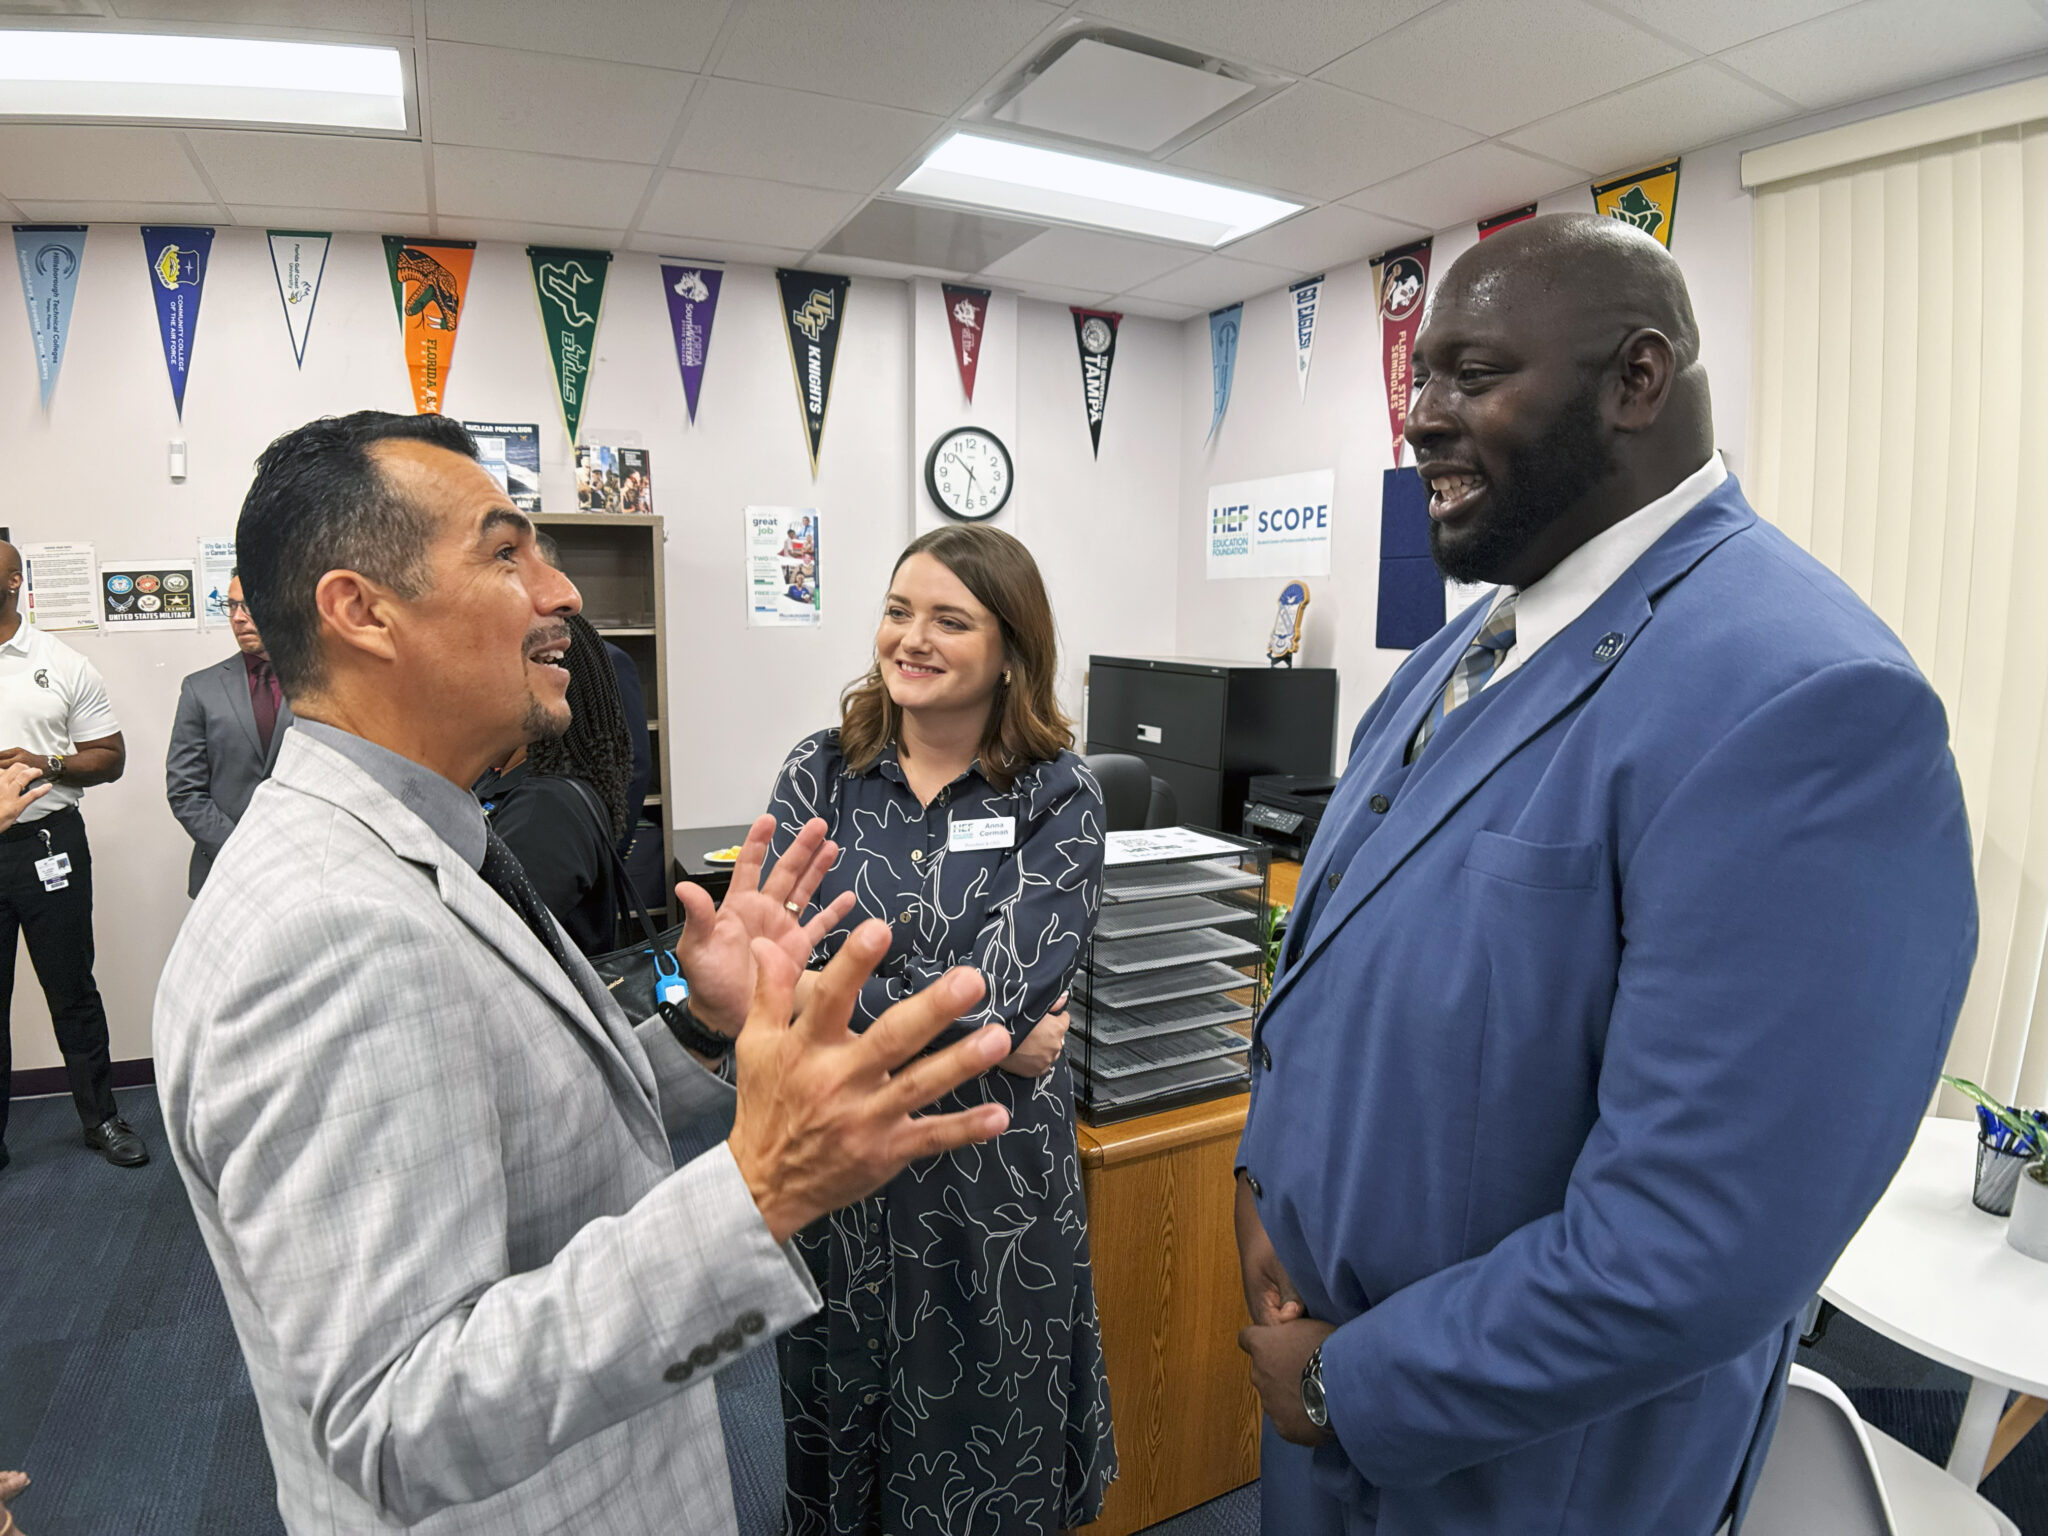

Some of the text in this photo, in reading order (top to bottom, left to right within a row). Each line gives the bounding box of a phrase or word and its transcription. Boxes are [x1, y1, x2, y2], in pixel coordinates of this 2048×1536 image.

[51, 252, 60, 364] Hillsborough Technical Colleges
[170, 301, 176, 312] OF
[793, 288, 834, 342] UCF
[1296, 286, 1317, 350] GO EAGLES!
[685, 303, 694, 367] SOUTHWESTERN
[692, 325, 702, 366] FLORIDA
[1100, 355, 1109, 369] THE
[426, 339, 437, 412] FLORIDA A&M
[808, 344, 822, 415] KNIGHTS
[1390, 344, 1399, 410] SEMINOLES
[1397, 330, 1407, 421] FLORIDA STATE
[1084, 354, 1101, 426] TAMPA
[465, 424, 494, 432] NUCLEAR
[954, 441, 963, 453] 11
[966, 438, 977, 449] 12
[982, 444, 987, 455] 1
[943, 452, 955, 464] 10
[990, 456, 998, 467] 2
[939, 466, 948, 478] 9
[993, 470, 1001, 482] 3
[943, 482, 951, 493] 8
[989, 485, 997, 496] 4
[952, 493, 960, 505] 7
[967, 498, 974, 510] 6
[980, 495, 988, 506] 5
[752, 518, 778, 527] great
[1213, 505, 1249, 534] HEF
[1258, 504, 1328, 533] SCOPE
[758, 527, 774, 536] job
[1212, 537, 1249, 548] EDUCATION
[1212, 546, 1249, 556] FOUNDATION
[108, 611, 192, 621] UNITED STATES MILITARY
